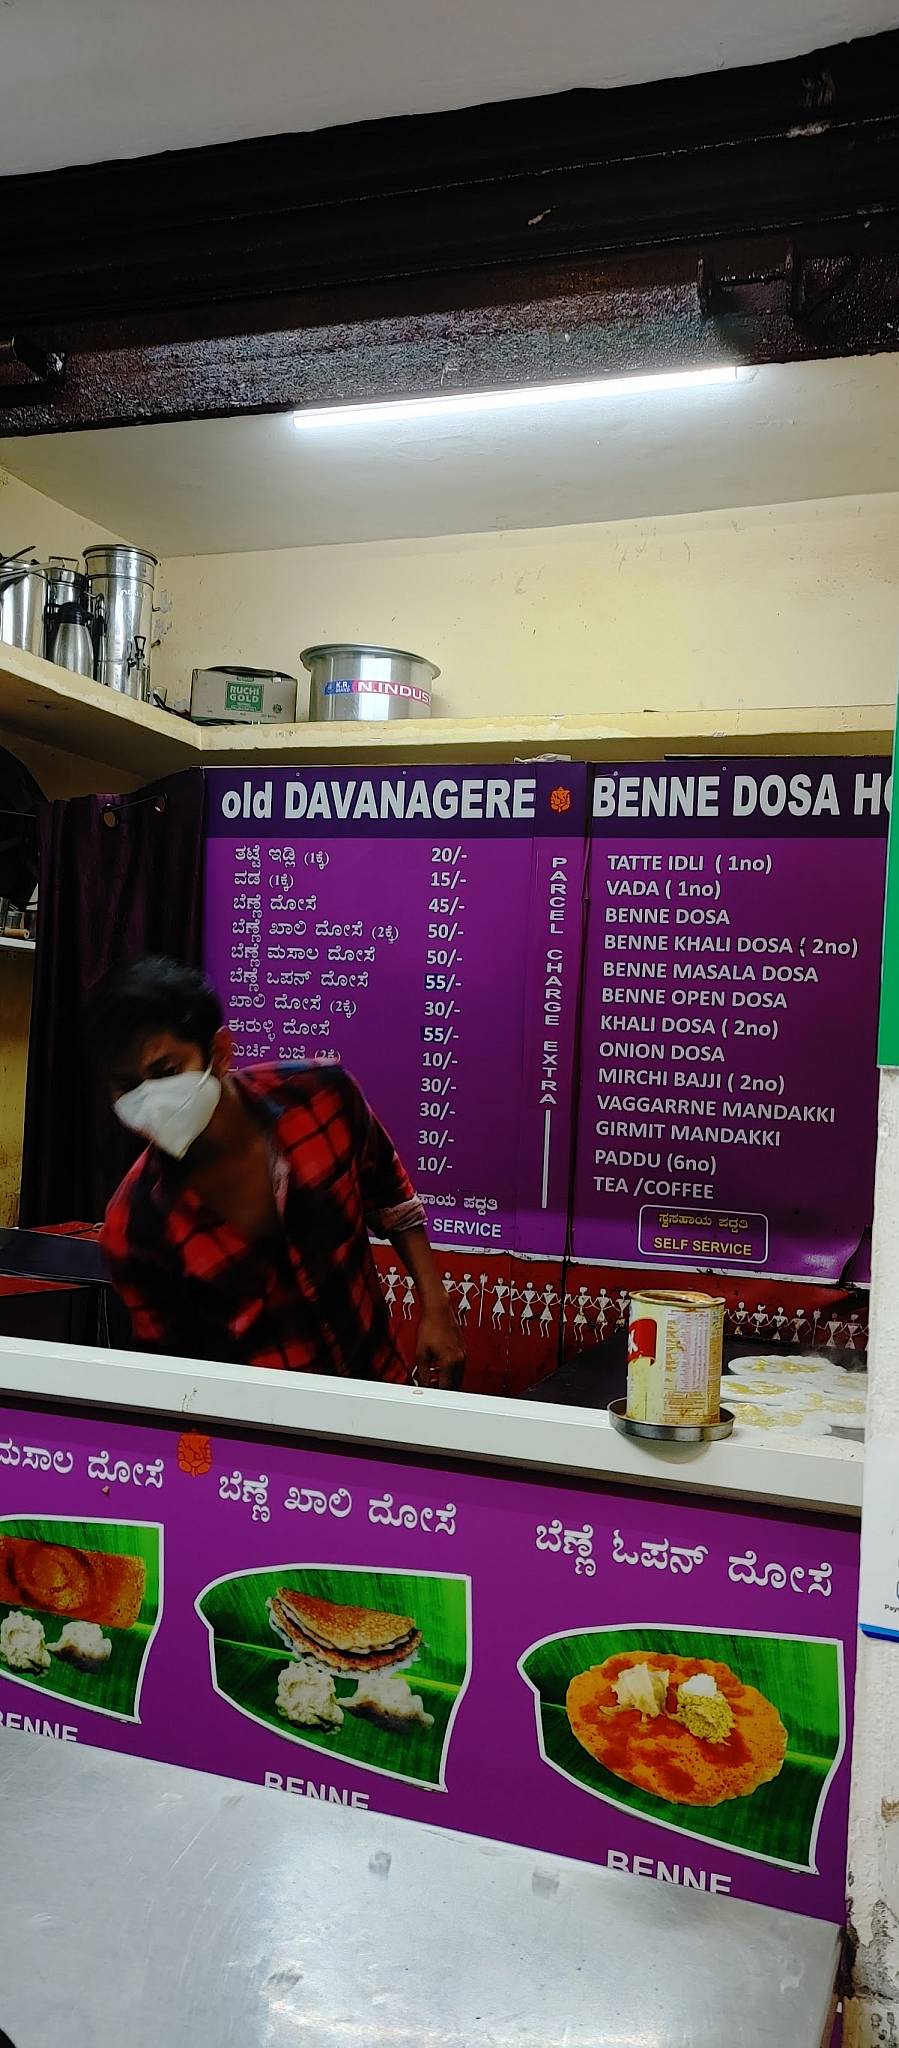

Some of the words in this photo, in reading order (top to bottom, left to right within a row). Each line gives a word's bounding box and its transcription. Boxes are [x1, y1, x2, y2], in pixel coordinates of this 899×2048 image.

[229, 694, 259, 703] GOLD
[230, 685, 260, 695] RUCHI
[222, 781, 273, 819] old
[284, 778, 537, 819] DAVANAGERE
[592, 775, 720, 817] BENNE
[733, 773, 840, 817] DOSA
[430, 846, 468, 865] 20/-
[608, 855, 662, 871] TATTE
[668, 855, 704, 871] IDLI
[234, 870, 261, 886] ವಡ
[430, 871, 467, 890] 15/-
[606, 881, 660, 896] VADA
[233, 893, 263, 919] ಬೆಣ್ಣೆ
[270, 894, 317, 911] ದೋಸೆ
[428, 897, 465, 916] 45/-
[549, 857, 568, 935] PARCEL
[605, 908, 670, 924] BENNE
[676, 909, 731, 925] DOSA
[232, 918, 262, 943] ಬೆಣ್ಣೆ
[268, 920, 307, 936] ಖಾಲಿ
[315, 920, 363, 937] ದೋಸೆ
[427, 921, 464, 941] 50/-
[604, 935, 668, 951] BENNE
[674, 937, 731, 953] KHALI
[737, 937, 793, 954] DOSA
[231, 943, 261, 968] ಬೆಣ್ಣೆ
[267, 944, 320, 960] ಮಸಾಲ
[327, 945, 376, 962] ದೋಸೆ
[426, 946, 463, 967] 50/-
[229, 967, 260, 992] ಬೆಣ್ಣೆ
[320, 970, 369, 988] ದೋಸೆ
[425, 972, 462, 992] 55/-
[603, 962, 667, 978] BENNE
[673, 963, 756, 981] MASALA
[762, 966, 819, 983] DOSA
[544, 948, 563, 1026] CHARGE
[229, 993, 266, 1008] ಖಾಲಿ
[274, 993, 322, 1011] ದೋಸೆ
[424, 999, 461, 1018] 30/-
[602, 988, 665, 1005] BENNE
[671, 990, 725, 1007] OPEN
[732, 991, 788, 1009] DOSA
[283, 1018, 330, 1036] ದೋಸೆ
[423, 1025, 459, 1044] 55/-
[600, 1015, 656, 1032] KHALI
[661, 1017, 716, 1035] DOSA
[422, 1051, 459, 1070] 10/-
[599, 1042, 665, 1059] ONION
[671, 1044, 726, 1062] DOSA
[539, 1040, 558, 1105] EXTRA
[598, 1068, 668, 1086] MIRCHI
[674, 1071, 722, 1090] BAJJI
[420, 1076, 457, 1095] 30/-
[419, 1101, 456, 1120] 30/-
[597, 1095, 717, 1116] VAGGARRNE
[722, 1101, 836, 1123] MANDAKKI
[418, 1129, 455, 1148] 30/-
[596, 1121, 665, 1140] GIRMIT
[671, 1124, 781, 1147] MANDAKKI
[417, 1155, 453, 1175] 10/-
[595, 1150, 661, 1168] PADDU
[667, 1153, 717, 1175] (6no)
[593, 1176, 629, 1194] TEA
[432, 1218, 502, 1238] SERVICE
[653, 1237, 689, 1251] SELF
[692, 1240, 752, 1256] SERVICE
[87, 1450, 165, 1489] ದೋಸೆ
[218, 1469, 271, 1524] ಬೆಣ್ಣೆ
[283, 1485, 353, 1518] ಖಾಲಿ
[367, 1493, 457, 1537] ದೋಸೆ
[535, 1519, 597, 1577] ಬೆಣ್ಣೆ
[727, 1549, 834, 1598] ದೋಸೆ
